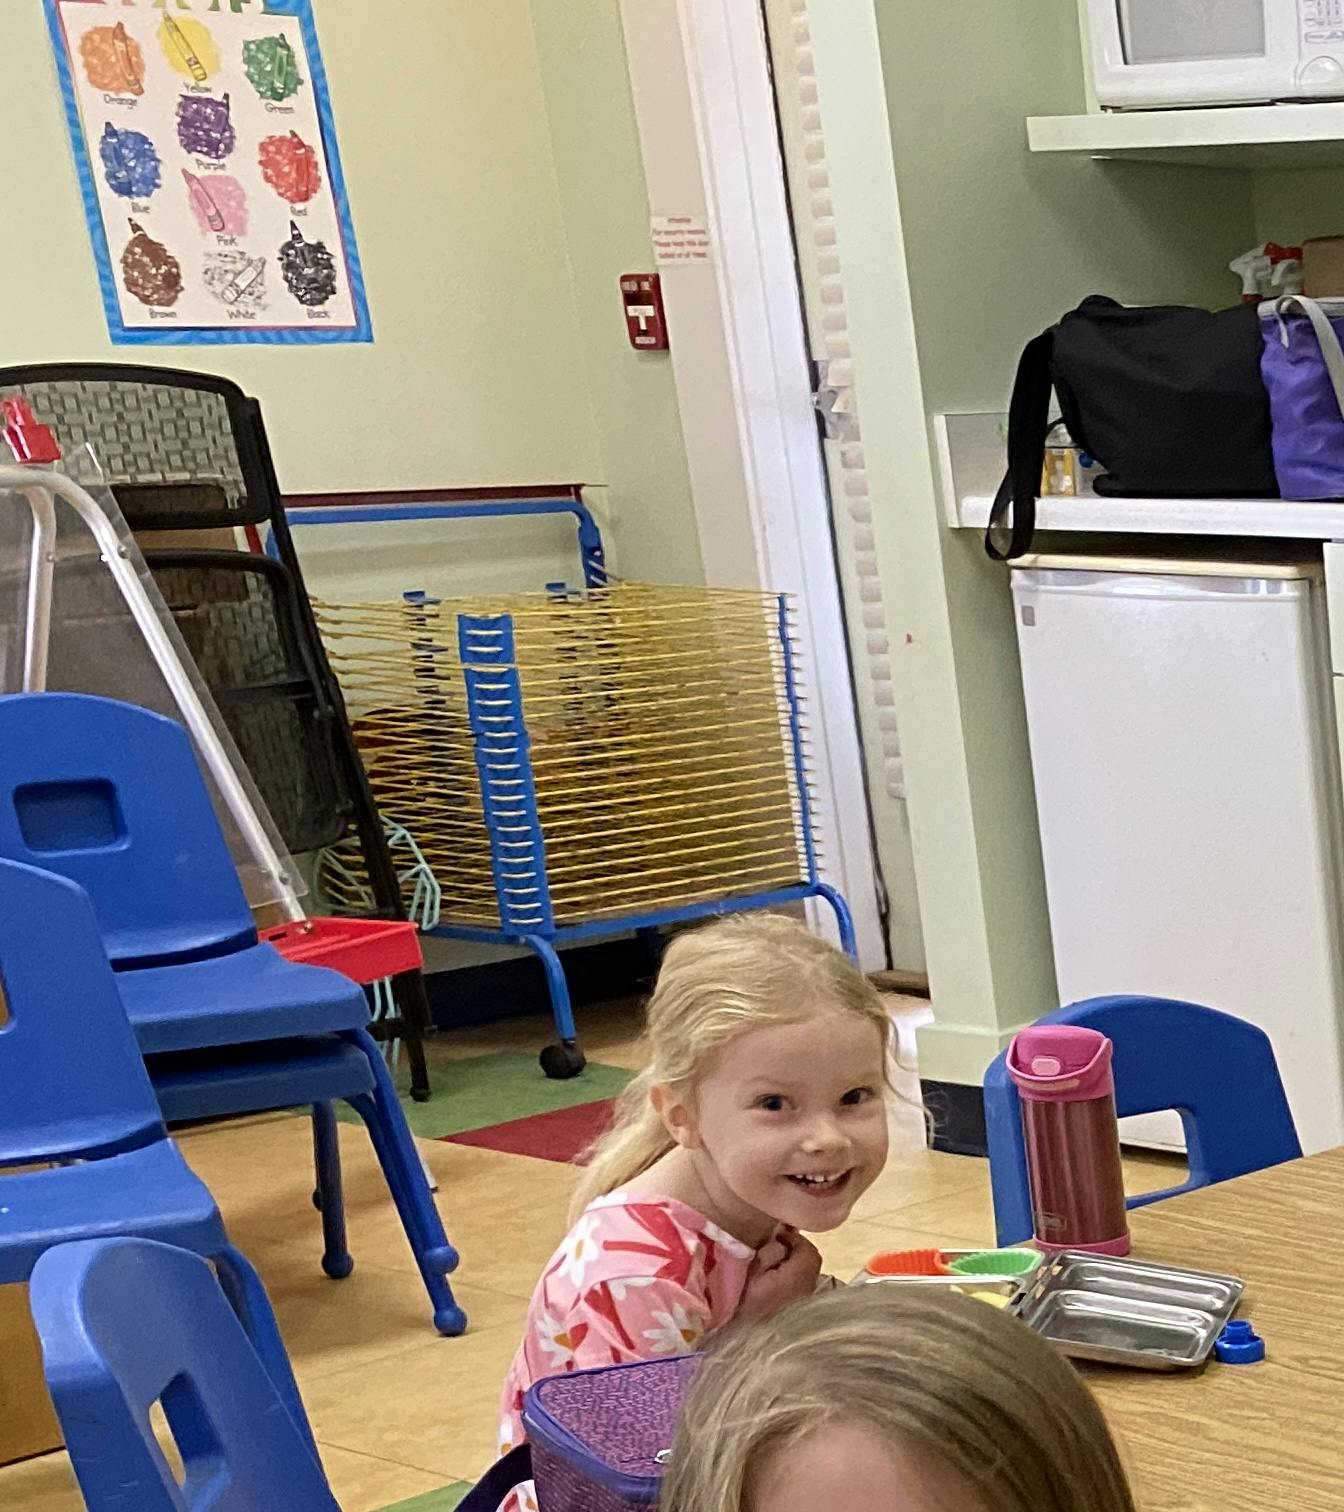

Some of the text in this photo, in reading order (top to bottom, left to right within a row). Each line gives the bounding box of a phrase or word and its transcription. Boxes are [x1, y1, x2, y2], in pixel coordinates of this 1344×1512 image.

[104, 94, 138, 110] Orange
[265, 102, 295, 114] Green
[197, 159, 227, 171] Purple
[226, 309, 256, 320] White
